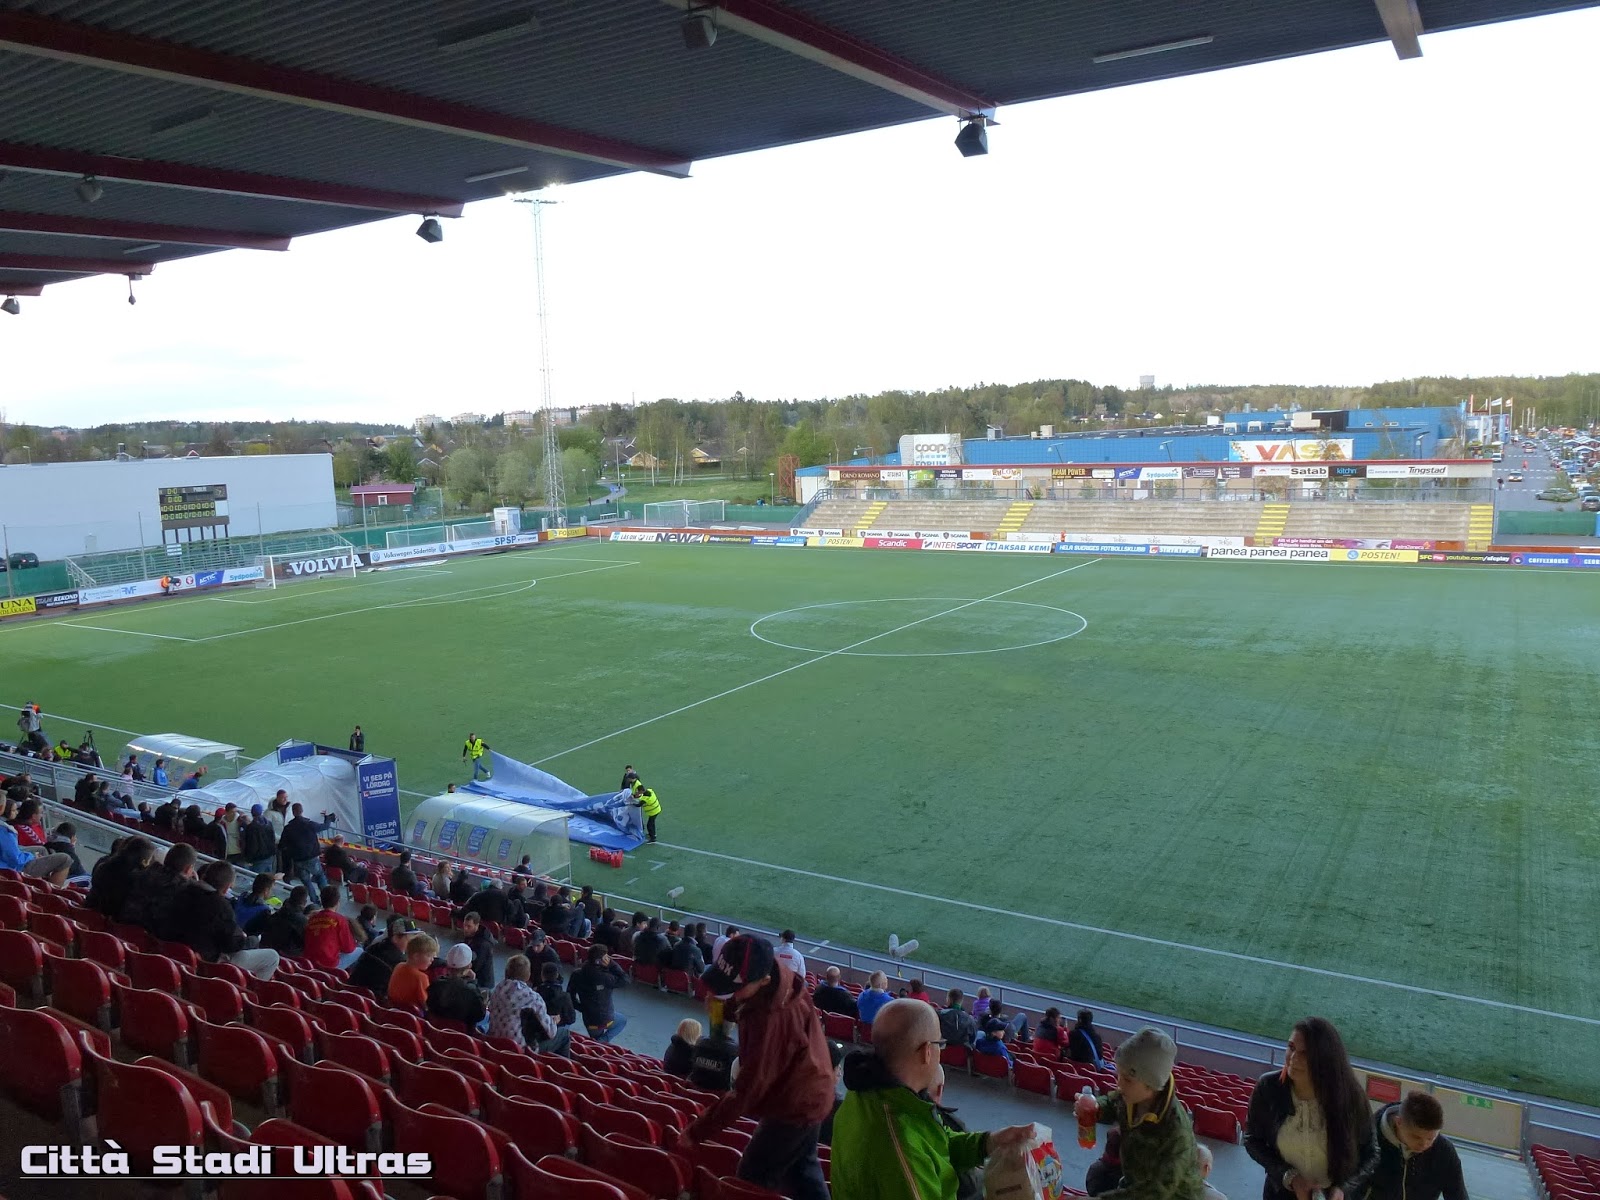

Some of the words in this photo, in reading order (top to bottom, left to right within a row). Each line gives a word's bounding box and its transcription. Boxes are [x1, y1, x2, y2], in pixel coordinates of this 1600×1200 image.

[915, 443, 946, 453] coop
[1255, 444, 1347, 460] VASA
[1290, 467, 1327, 475] Satab
[1408, 466, 1446, 475] Tingstad
[878, 539, 907, 547] Scandic
[932, 541, 982, 549] INTERSPORT
[383, 550, 413, 559] Volkswagen
[1210, 547, 1248, 557] panea
[1249, 548, 1288, 558] panea
[1289, 549, 1329, 559] panea
[1361, 552, 1401, 560] POSTEN!
[289, 554, 364, 576] VOLVIA
[53, 593, 79, 602] REKOND
[370, 774, 383, 782] SES
[383, 771, 393, 780] PÅ
[366, 781, 391, 789] LÖRDAG
